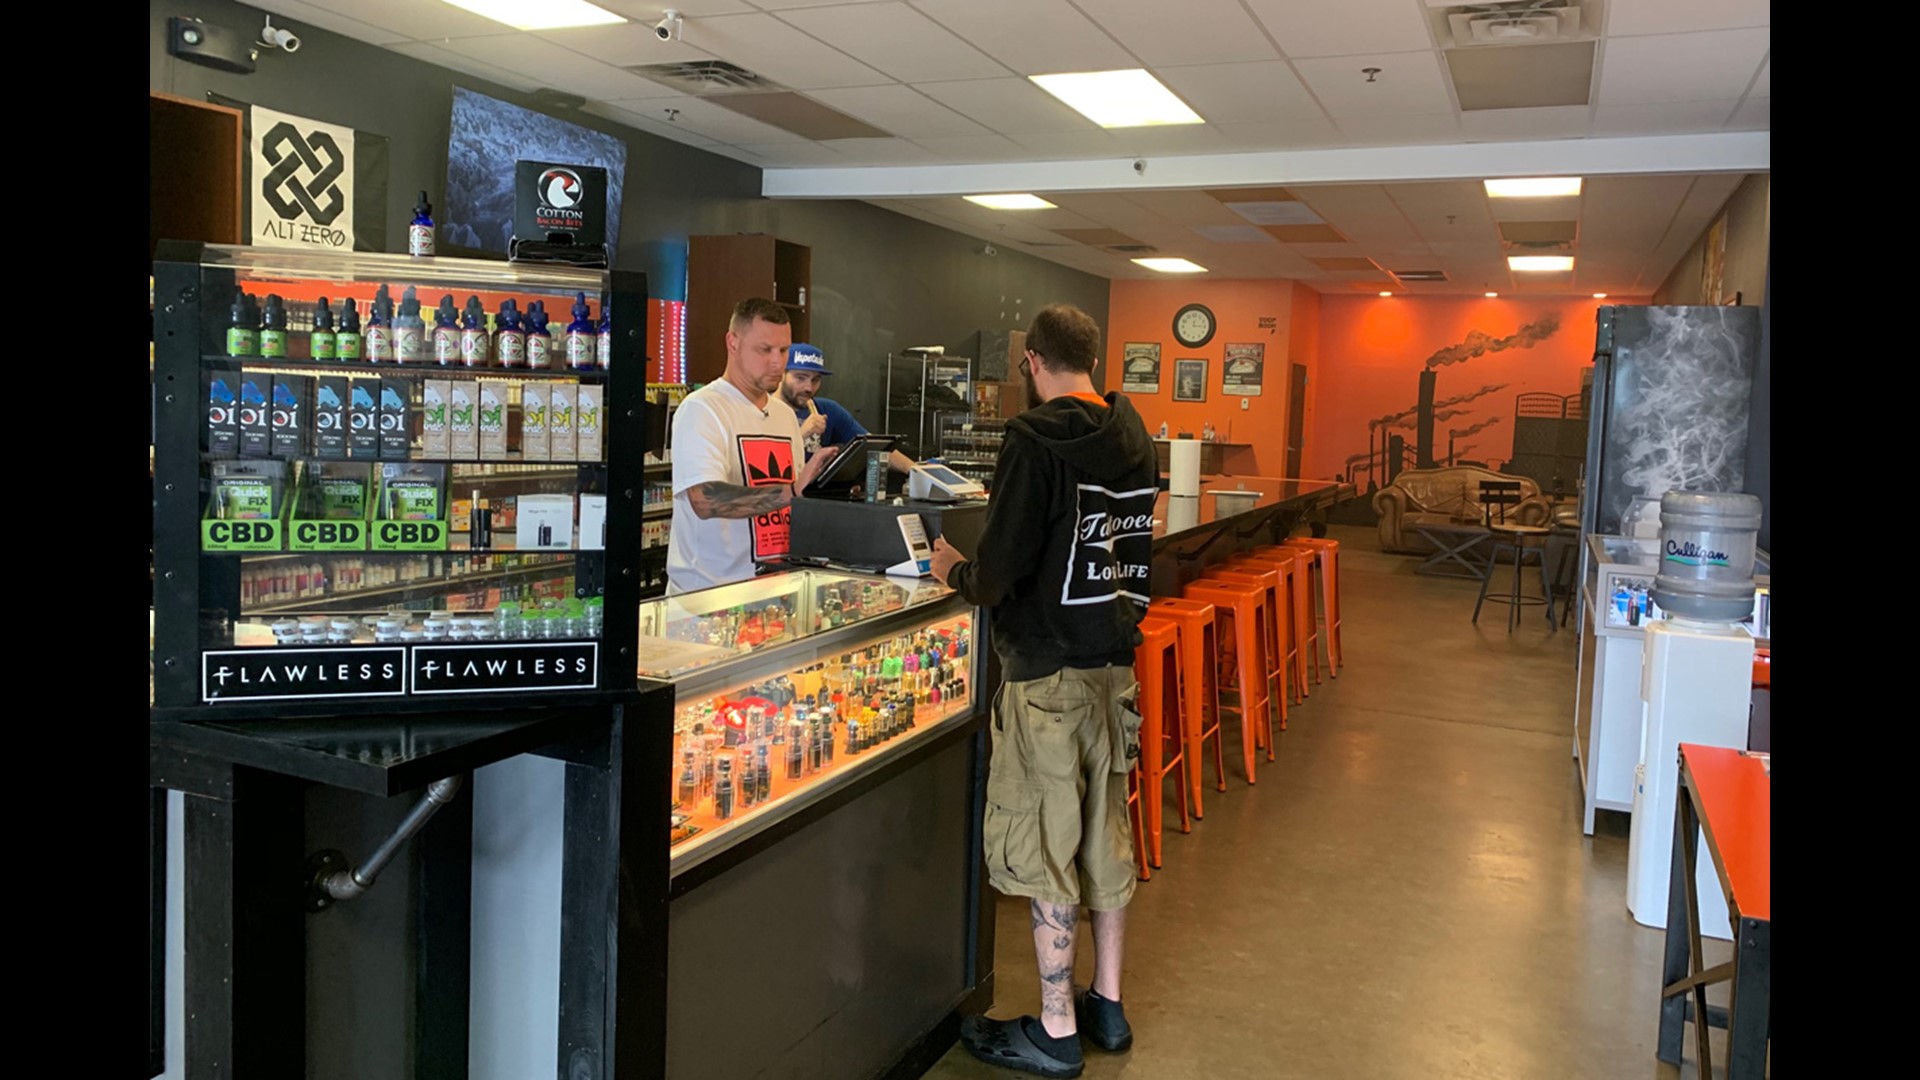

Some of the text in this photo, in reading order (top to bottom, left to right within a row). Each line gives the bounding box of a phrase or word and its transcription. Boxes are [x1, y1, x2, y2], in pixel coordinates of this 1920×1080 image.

[536, 207, 583, 219] COTTON
[262, 219, 296, 240] ALT
[230, 486, 268, 497] Quick
[248, 497, 268, 506] FIX
[399, 488, 433, 499] Quick
[415, 499, 433, 507] FIX
[209, 522, 274, 543] CBD
[297, 522, 359, 543] CBD
[380, 522, 440, 543] CBD
[1666, 540, 1729, 566] Culligan
[212, 663, 394, 686] FLAWLESS
[420, 657, 587, 679] FLAWLESS
